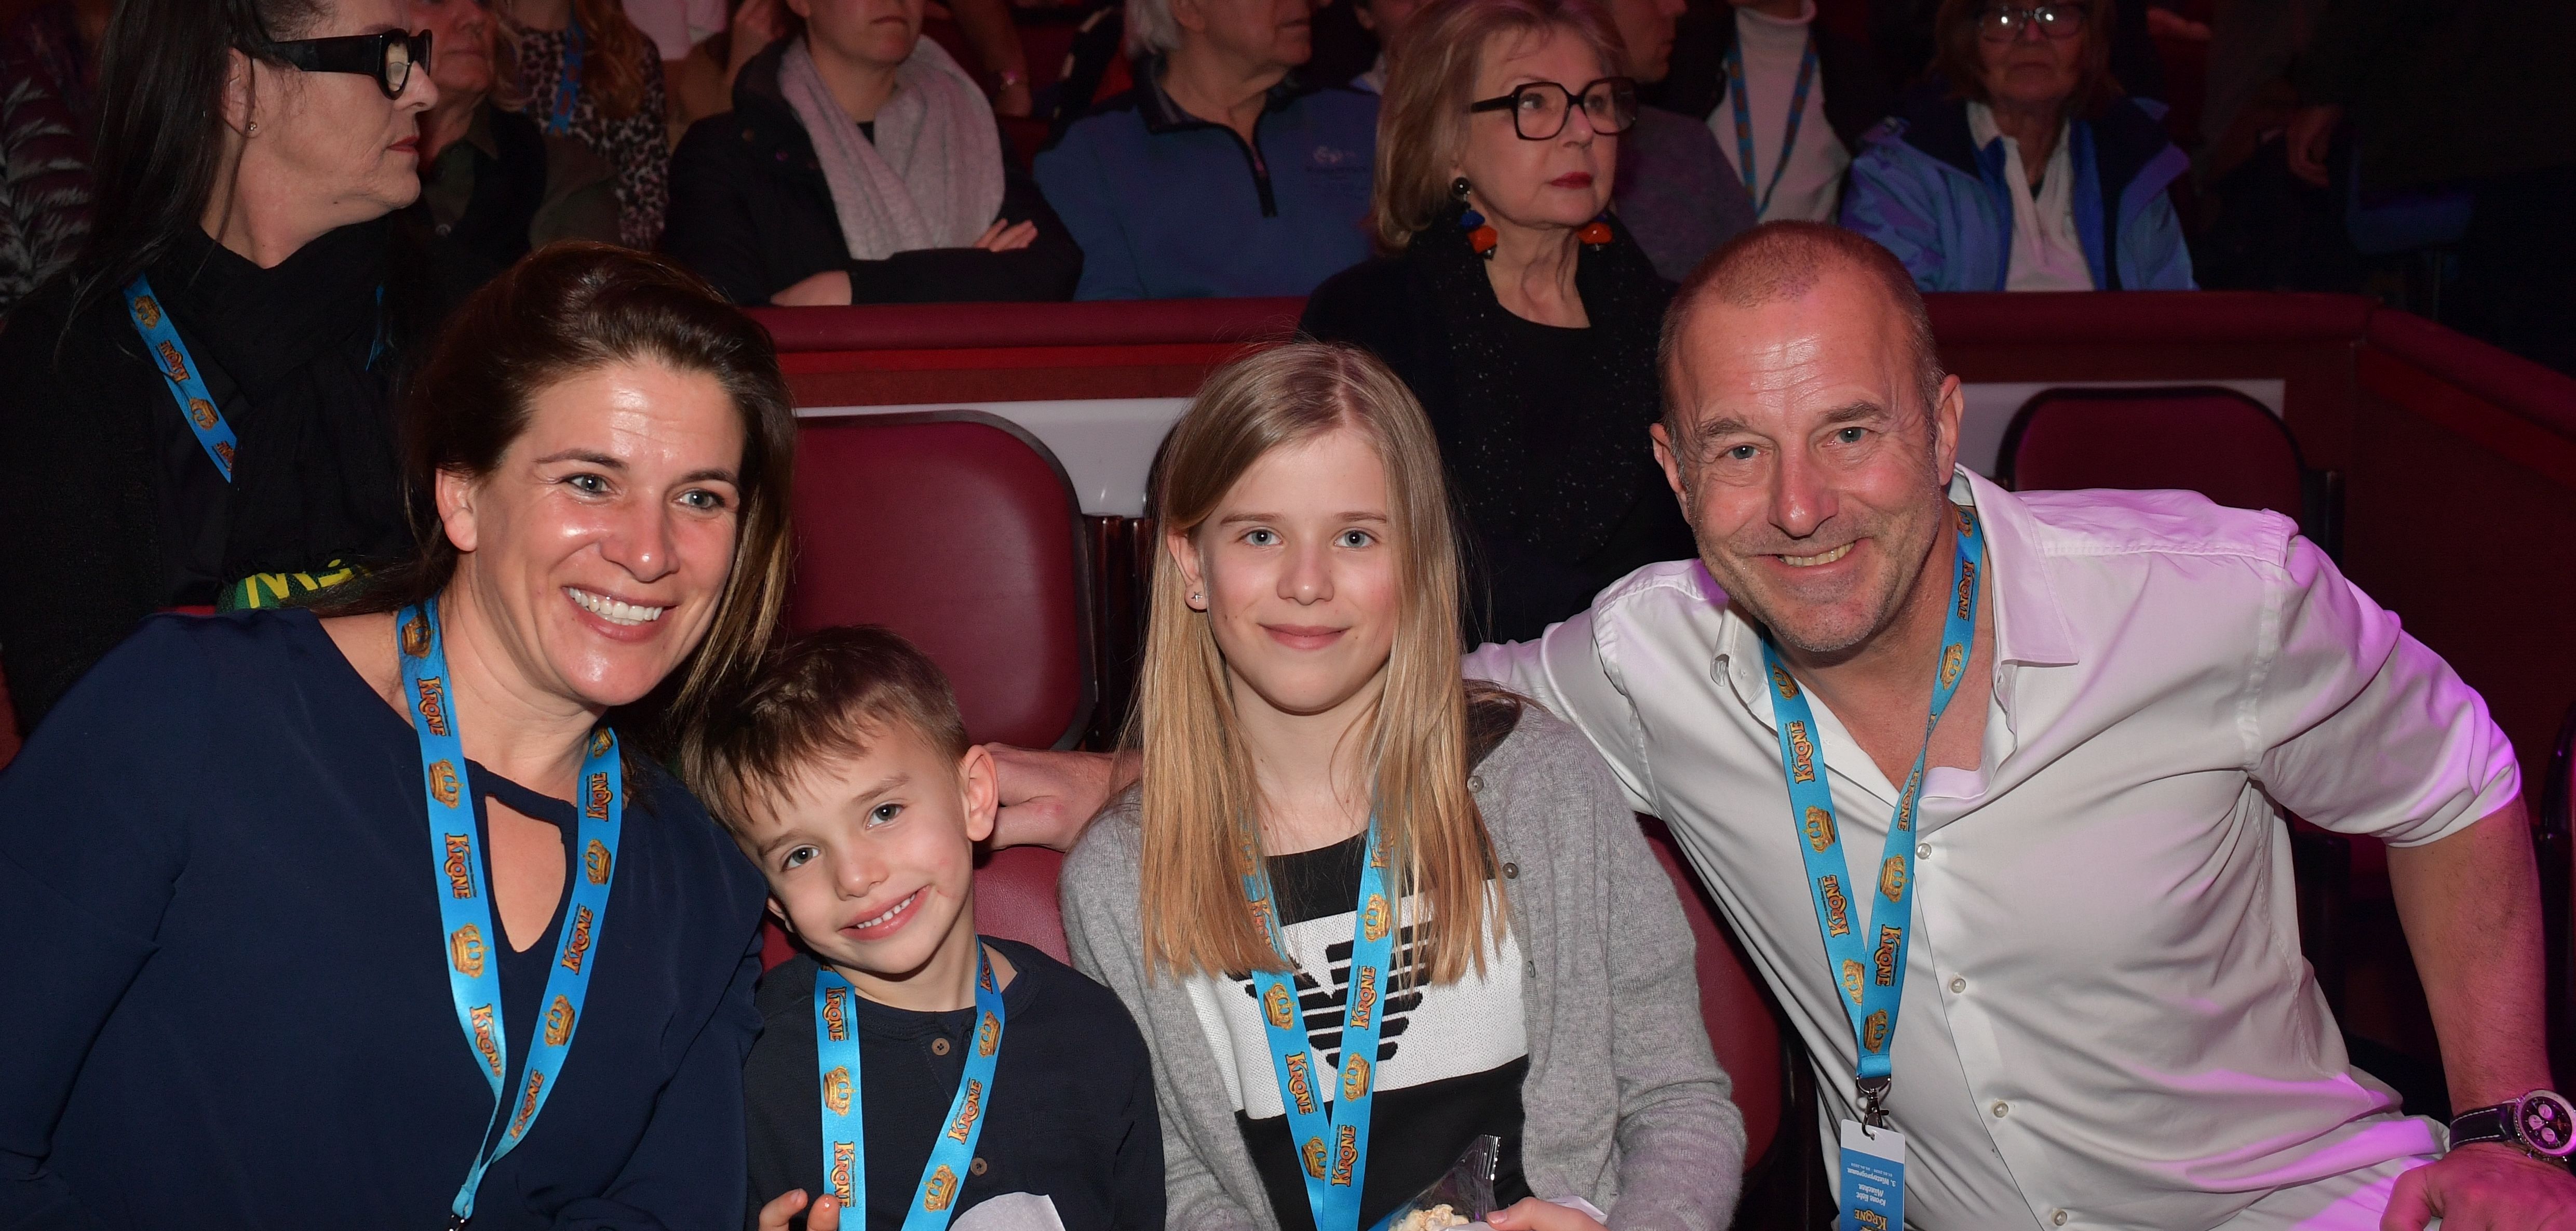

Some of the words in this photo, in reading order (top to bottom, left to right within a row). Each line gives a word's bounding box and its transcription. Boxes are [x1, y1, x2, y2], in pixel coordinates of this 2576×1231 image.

[214, 440, 235, 472] ONE
[1957, 557, 1975, 621] KRONE
[417, 676, 447, 737] KRONE
[1795, 720, 1816, 785] KRONE
[586, 772, 613, 822] KRONE
[1898, 769, 1920, 832] KRONE
[444, 833, 471, 900] KRONE
[1828, 874, 1848, 938] KRONE
[561, 906, 594, 975] KRONE
[1874, 924, 1902, 987] KRONE
[822, 987, 844, 1041] KRONE
[1350, 965, 1377, 1030] KRONE
[469, 1003, 502, 1077] KRONE
[509, 1069, 544, 1143] KRONE
[947, 1079, 983, 1144] KRONE
[1285, 1052, 1315, 1115] KRONE
[831, 1141, 855, 1209] KRONE
[1330, 1124, 1356, 1187] KRONE
[1854, 1209, 1887, 1230] KRONE
[1858, 1184, 1884, 1197] München
